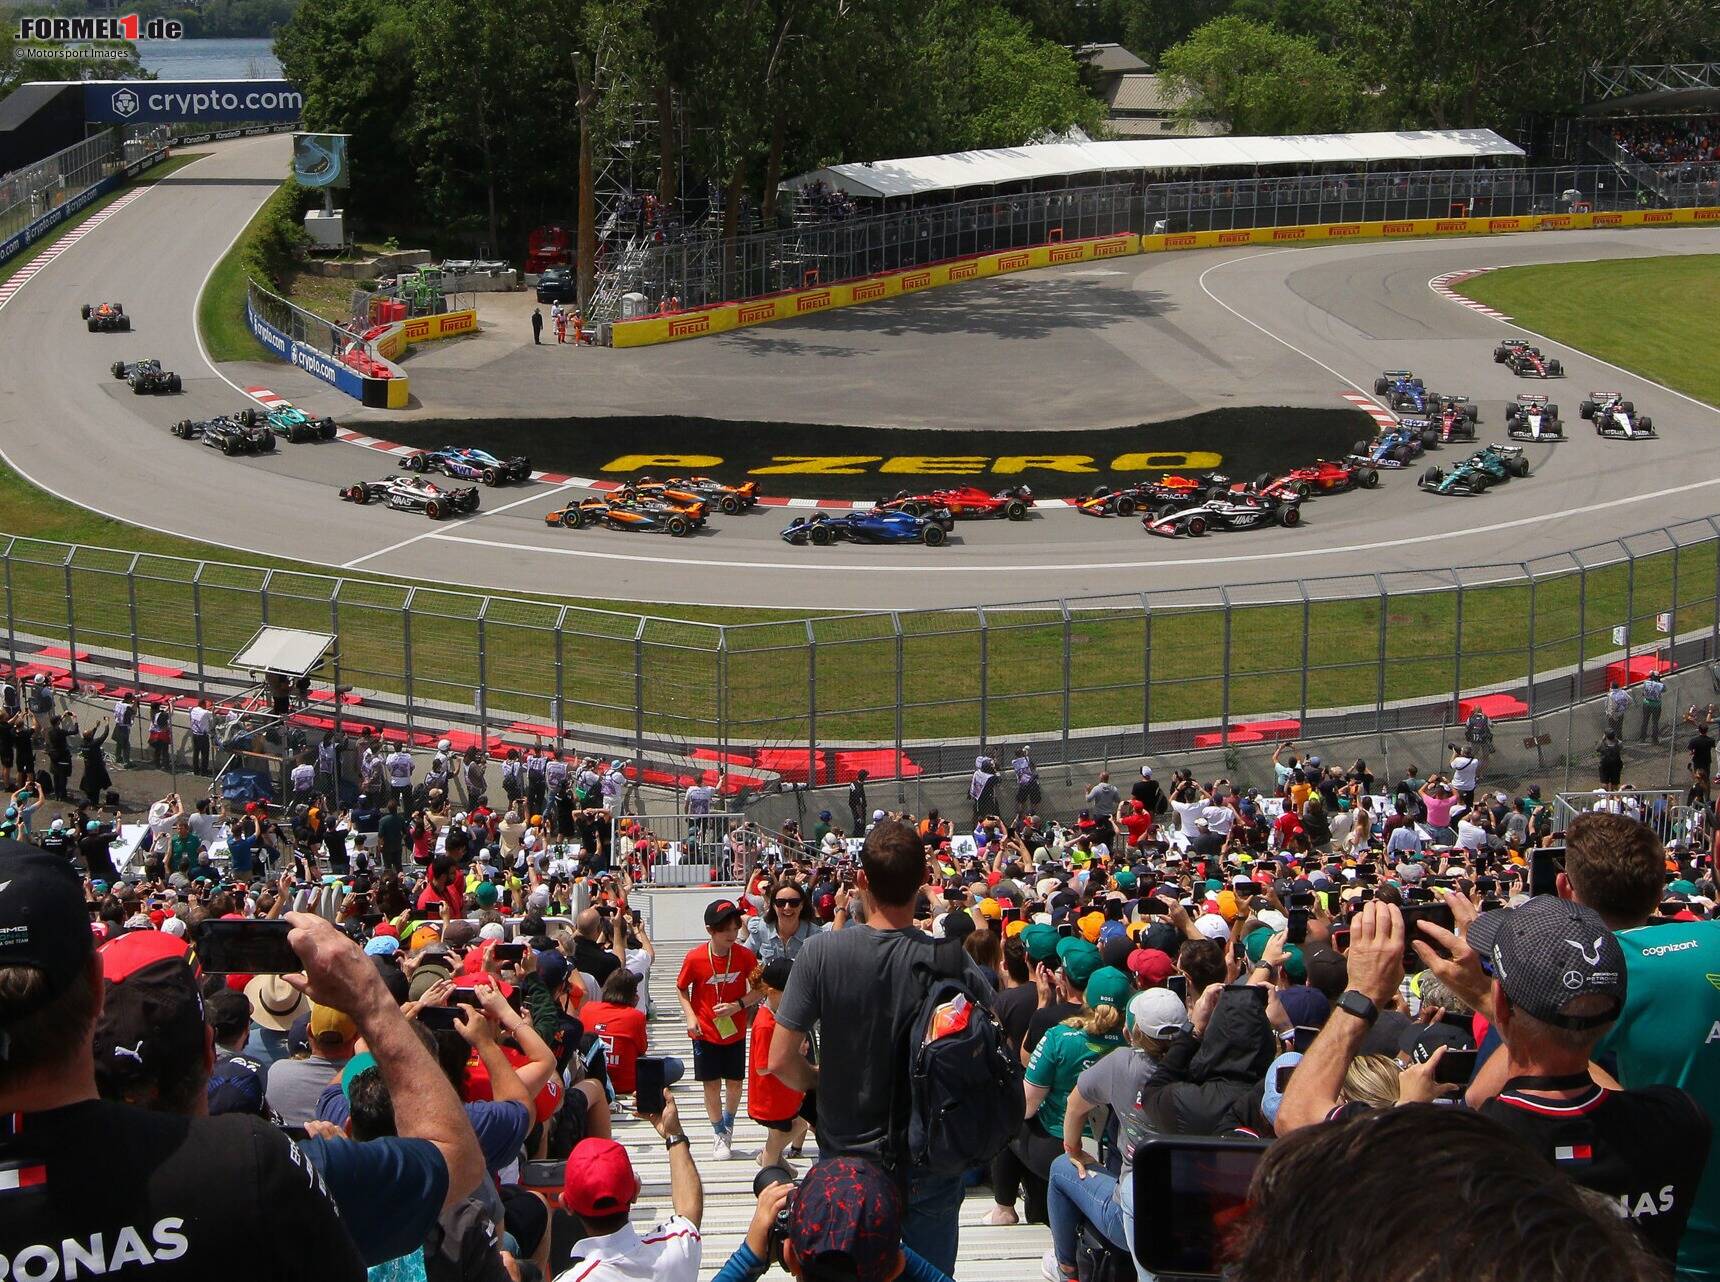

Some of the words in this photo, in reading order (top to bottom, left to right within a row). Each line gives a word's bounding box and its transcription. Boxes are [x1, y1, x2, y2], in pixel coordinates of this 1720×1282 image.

[149, 90, 303, 115] crypto.com
[1489, 218, 1520, 229] PIRELLI
[1694, 210, 1720, 220] PIRELL
[31, 210, 62, 239] crypto.com
[1328, 225, 1361, 237] PIRELLI
[1383, 223, 1414, 234] PIRELLI
[1436, 221, 1467, 232] PIRELLI
[1164, 236, 1197, 247] PIRELLI
[1218, 232, 1250, 244] PIRELLI
[1273, 229, 1305, 240] PIRELLI
[1049, 246, 1083, 262] PIRELLI
[1094, 240, 1127, 257] PIRELLI
[998, 254, 1029, 271] PIRELLI
[902, 272, 931, 290] PIRELLI
[949, 263, 978, 281] PIRELLI
[852, 282, 885, 301] PIRELLI
[797, 292, 831, 312] PIRELLI
[738, 303, 776, 324] PIRELLI
[440, 315, 472, 333] PIRELLI
[669, 316, 710, 337] PIRELLI
[257, 322, 286, 353] crypto.com
[298, 351, 337, 383] crypto.com
[600, 454, 725, 472] P
[747, 451, 1224, 474] ZERO
[1642, 939, 1699, 957] cognizant
[0, 1216, 189, 1282] ONAS
